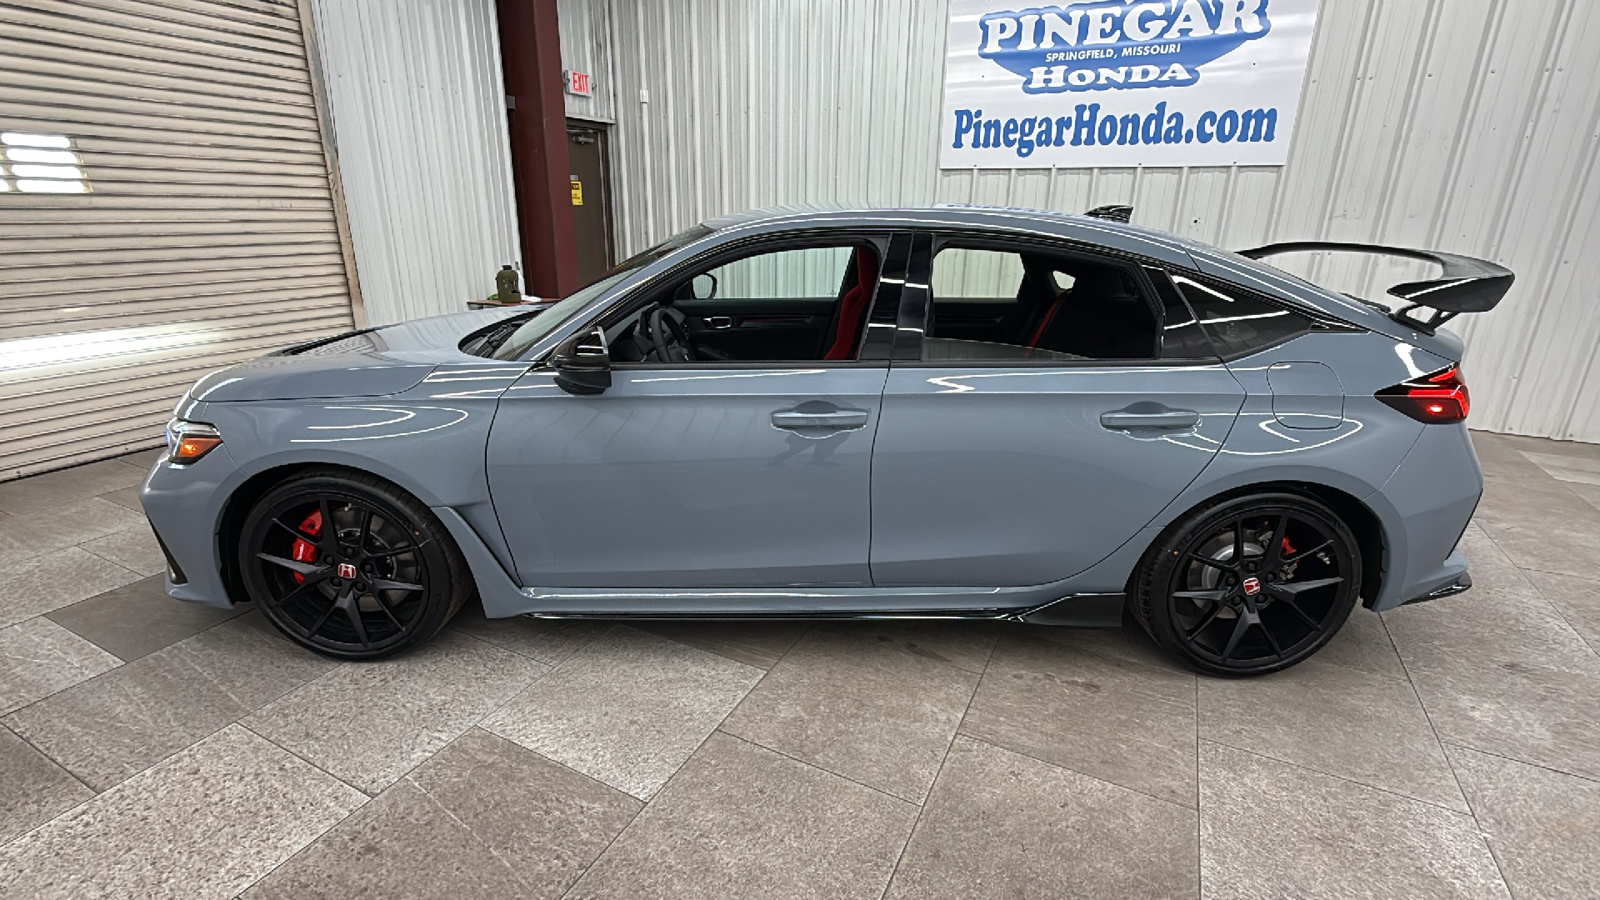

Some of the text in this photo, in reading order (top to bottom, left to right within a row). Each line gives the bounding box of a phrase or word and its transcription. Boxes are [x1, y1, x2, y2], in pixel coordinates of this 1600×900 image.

[983, 0, 1263, 53] PINEGAR
[1045, 43, 1181, 63] SPRINGFIELD, MISSOURI
[572, 71, 589, 93] EXIT
[1028, 63, 1193, 88] HONDA
[952, 101, 1277, 158] PinegarHonda.com
